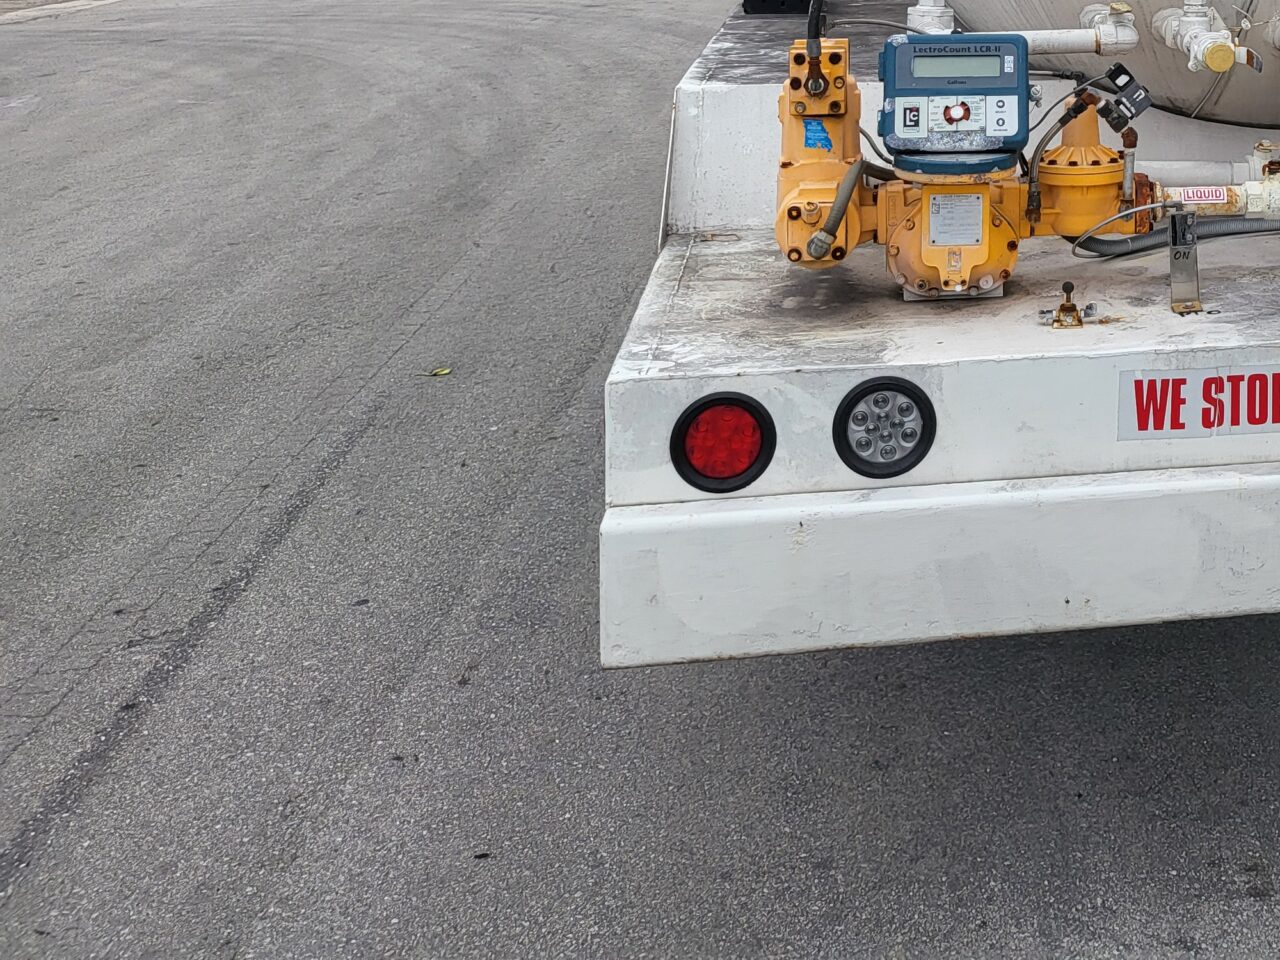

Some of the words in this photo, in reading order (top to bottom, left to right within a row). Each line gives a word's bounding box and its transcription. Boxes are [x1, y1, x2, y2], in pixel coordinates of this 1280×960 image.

[913, 45, 972, 54] LectroCount
[1186, 189, 1222, 199] LIQUID
[1174, 250, 1190, 260] ON
[1134, 377, 1188, 431] WE
